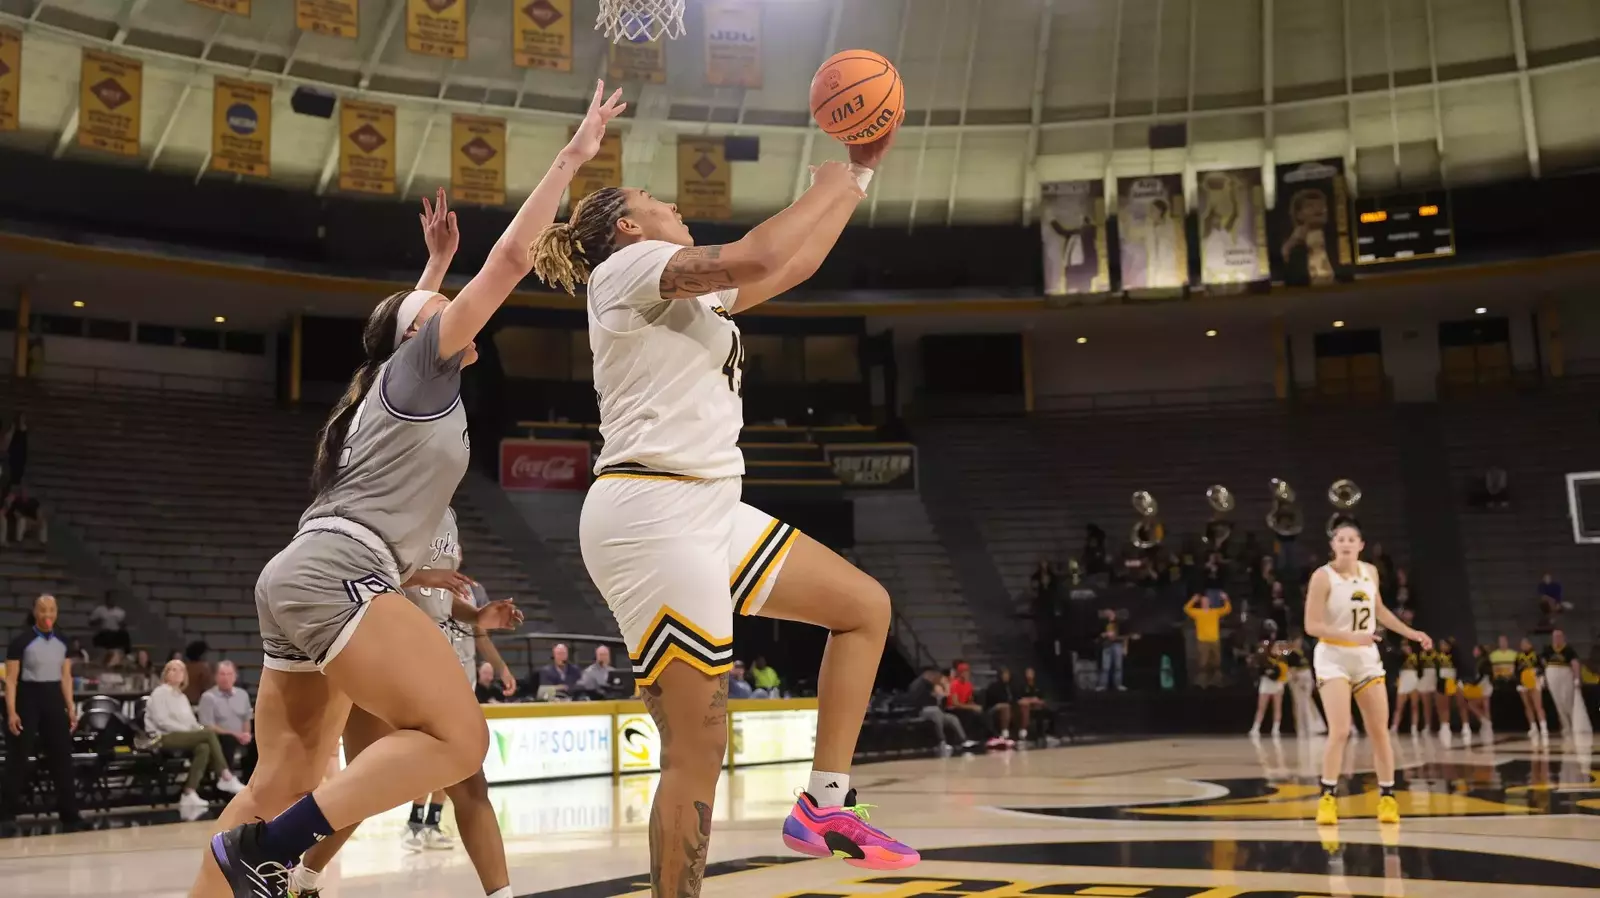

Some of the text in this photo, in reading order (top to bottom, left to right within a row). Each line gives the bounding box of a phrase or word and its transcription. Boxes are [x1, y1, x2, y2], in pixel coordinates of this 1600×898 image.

[836, 108, 894, 142] Wilson
[511, 455, 577, 480] Coca-Cola
[1351, 607, 1370, 631] 12
[519, 727, 609, 754] AIRSOUTH
